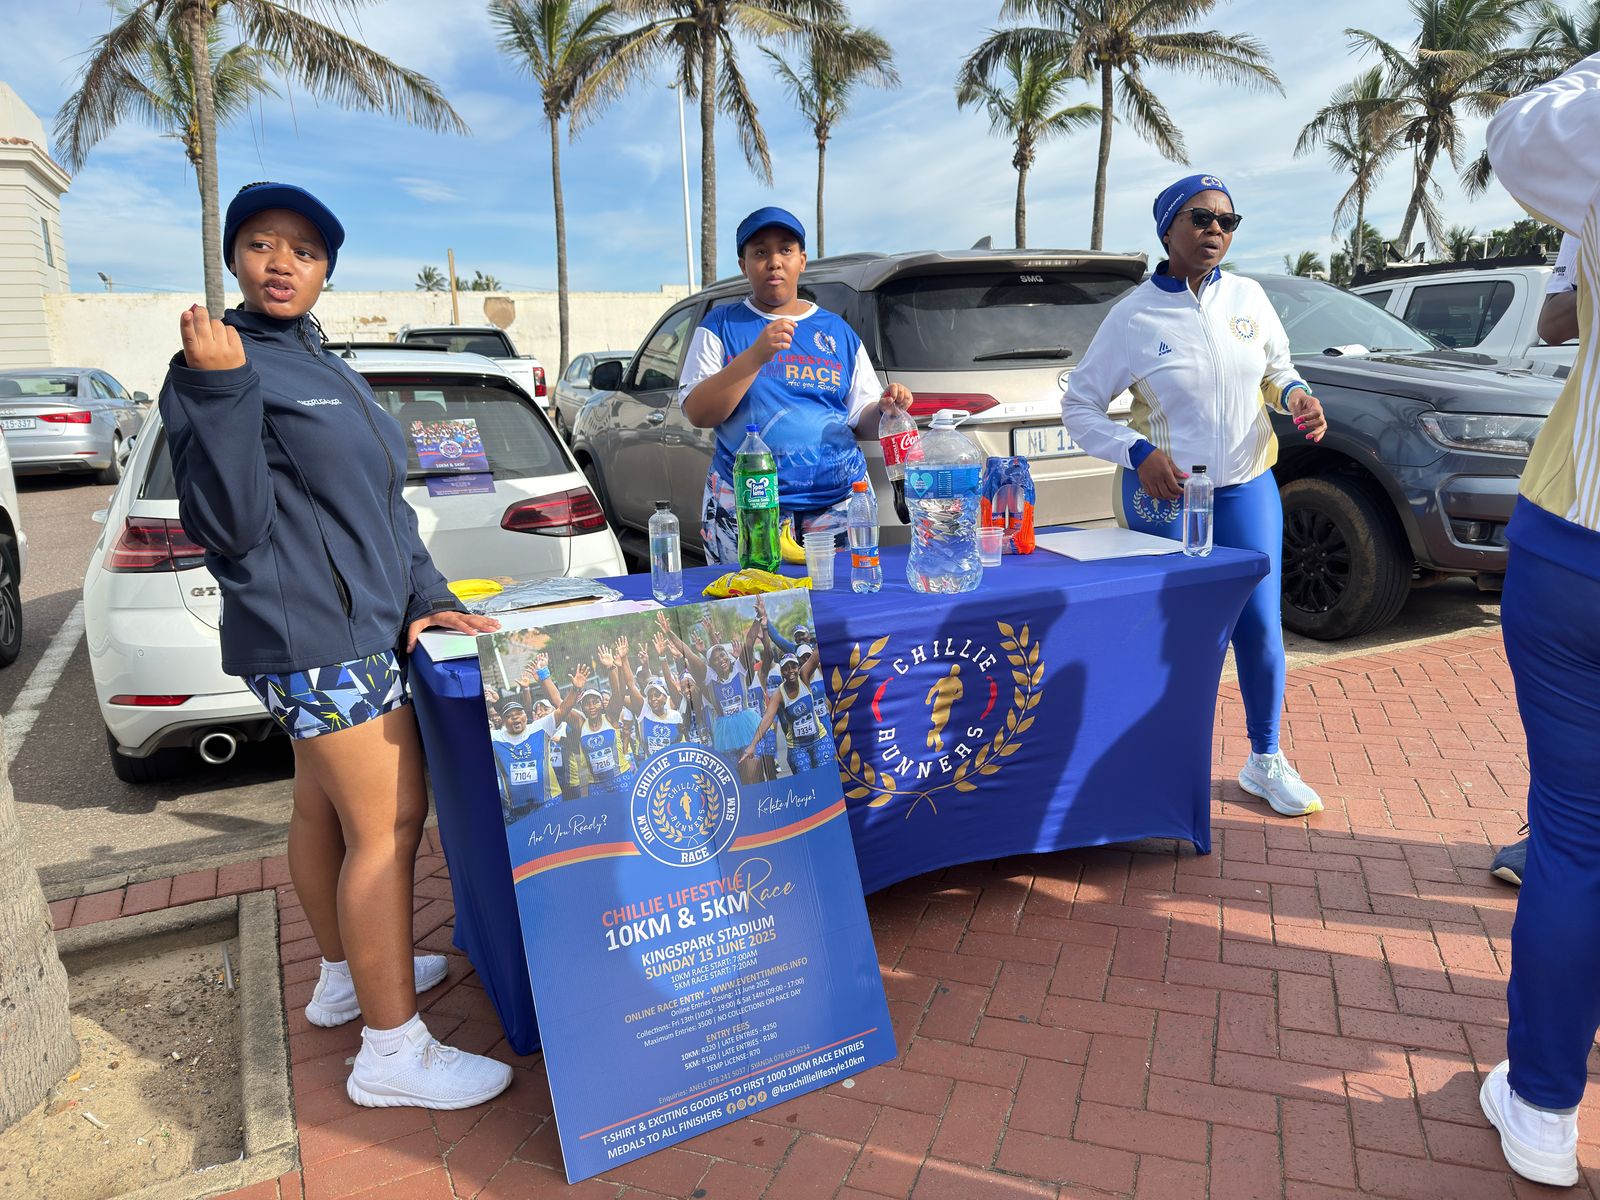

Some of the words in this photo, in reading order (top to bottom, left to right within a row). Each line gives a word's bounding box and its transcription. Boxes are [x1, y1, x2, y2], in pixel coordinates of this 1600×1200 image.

[778, 353, 843, 371] LIFESTYLE
[786, 364, 842, 386] RACE
[786, 378, 801, 387] Are
[802, 381, 815, 389] you
[1027, 430, 1047, 457] NU
[892, 638, 997, 675] CHILLIE
[797, 726, 813, 735] 7334
[878, 726, 984, 779] RUNNERS
[514, 772, 532, 781] 7104
[636, 757, 671, 798] CHILLIE
[678, 751, 732, 785] LIFESTYLE
[668, 782, 701, 799] CHILLIE
[671, 809, 705, 832] RUNNERS
[726, 797, 736, 821] 5KM
[527, 831, 544, 846] Are
[543, 823, 571, 844] You
[568, 814, 608, 836] Ready?
[637, 814, 656, 844] 10KM
[680, 846, 710, 863] RACE
[603, 895, 664, 927] CHILLIE
[668, 873, 744, 909] LIFESTYLE
[733, 857, 796, 912] Race
[605, 913, 671, 951] 10KM
[677, 907, 696, 929] &
[701, 890, 749, 922] 5KM
[641, 934, 716, 967] KINGSPARK
[718, 915, 775, 943] STADIUM
[645, 954, 697, 981] SUNDAY
[700, 948, 714, 964] 15
[716, 938, 746, 958] JUNE
[749, 928, 777, 948] 2025
[671, 970, 691, 984] 10KM
[692, 965, 710, 979] RACE
[710, 957, 732, 971] START:
[732, 949, 758, 963] 7:00AM
[674, 979, 691, 992] 5KM
[691, 973, 710, 987] RACE
[710, 965, 732, 979] START:
[732, 957, 758, 972] 7:20AM
[624, 1006, 656, 1024] ONLINE
[657, 999, 679, 1013] RACE
[680, 990, 705, 1006] ENTRY
[710, 956, 808, 995] WWW.EVENTTIMING.INFO
[671, 1006, 690, 1017] Online
[691, 999, 711, 1012] Entries
[712, 992, 733, 1004] Closing:
[742, 984, 756, 993] June
[756, 978, 770, 989] 2025
[636, 1023, 672, 1040] Collections:
[671, 1019, 681, 1028] Fri
[681, 1014, 695, 1024] 13th
[695, 1007, 714, 1020] (10:00
[717, 1000, 736, 1012] 19:00)
[742, 995, 752, 1004] Sat
[752, 990, 766, 1001] 14th
[766, 984, 784, 996] (09:00
[787, 977, 805, 989] 17:00)
[644, 1032, 674, 1048] Maximum
[675, 1025, 697, 1037] Entries:
[727, 1001, 766, 1019] COLLECTIONS
[765, 997, 775, 1006] ON
[775, 992, 790, 1003] RACE
[790, 988, 802, 998] DAY
[681, 1049, 701, 1062] 10KM:
[701, 1043, 717, 1054] R220
[721, 1037, 735, 1048] LATE
[735, 1028, 759, 1041] ENTRIES
[762, 1021, 778, 1032] R250
[706, 1026, 731, 1043] ENTRY
[732, 1021, 751, 1034] FEES
[684, 1060, 702, 1071] 5KM:
[721, 1047, 735, 1058] LATE
[735, 1038, 760, 1052] ENTRIES
[707, 1061, 724, 1073] TEMP
[725, 1052, 749, 1067] LICENSE:
[749, 1048, 761, 1057] R70
[601, 1124, 637, 1146] T-SHIRT
[638, 1121, 647, 1133] &
[648, 1105, 689, 1129] EXCITING
[689, 1090, 729, 1113] GOODIES
[729, 1085, 743, 1099] TO
[743, 1077, 765, 1094] FIRST
[767, 1069, 787, 1084] 1000
[788, 1059, 812, 1077] 10KM
[812, 1052, 833, 1067] RACE
[834, 1040, 865, 1059] ENTRIES
[607, 1137, 646, 1160] MEDALS
[646, 1132, 660, 1144] TO
[661, 1125, 678, 1139] ALL
[678, 1107, 723, 1133] FINISHERS
[771, 1054, 866, 1098] @kznchillielifestyle10km
[658, 1090, 688, 1105] Enquiries:
